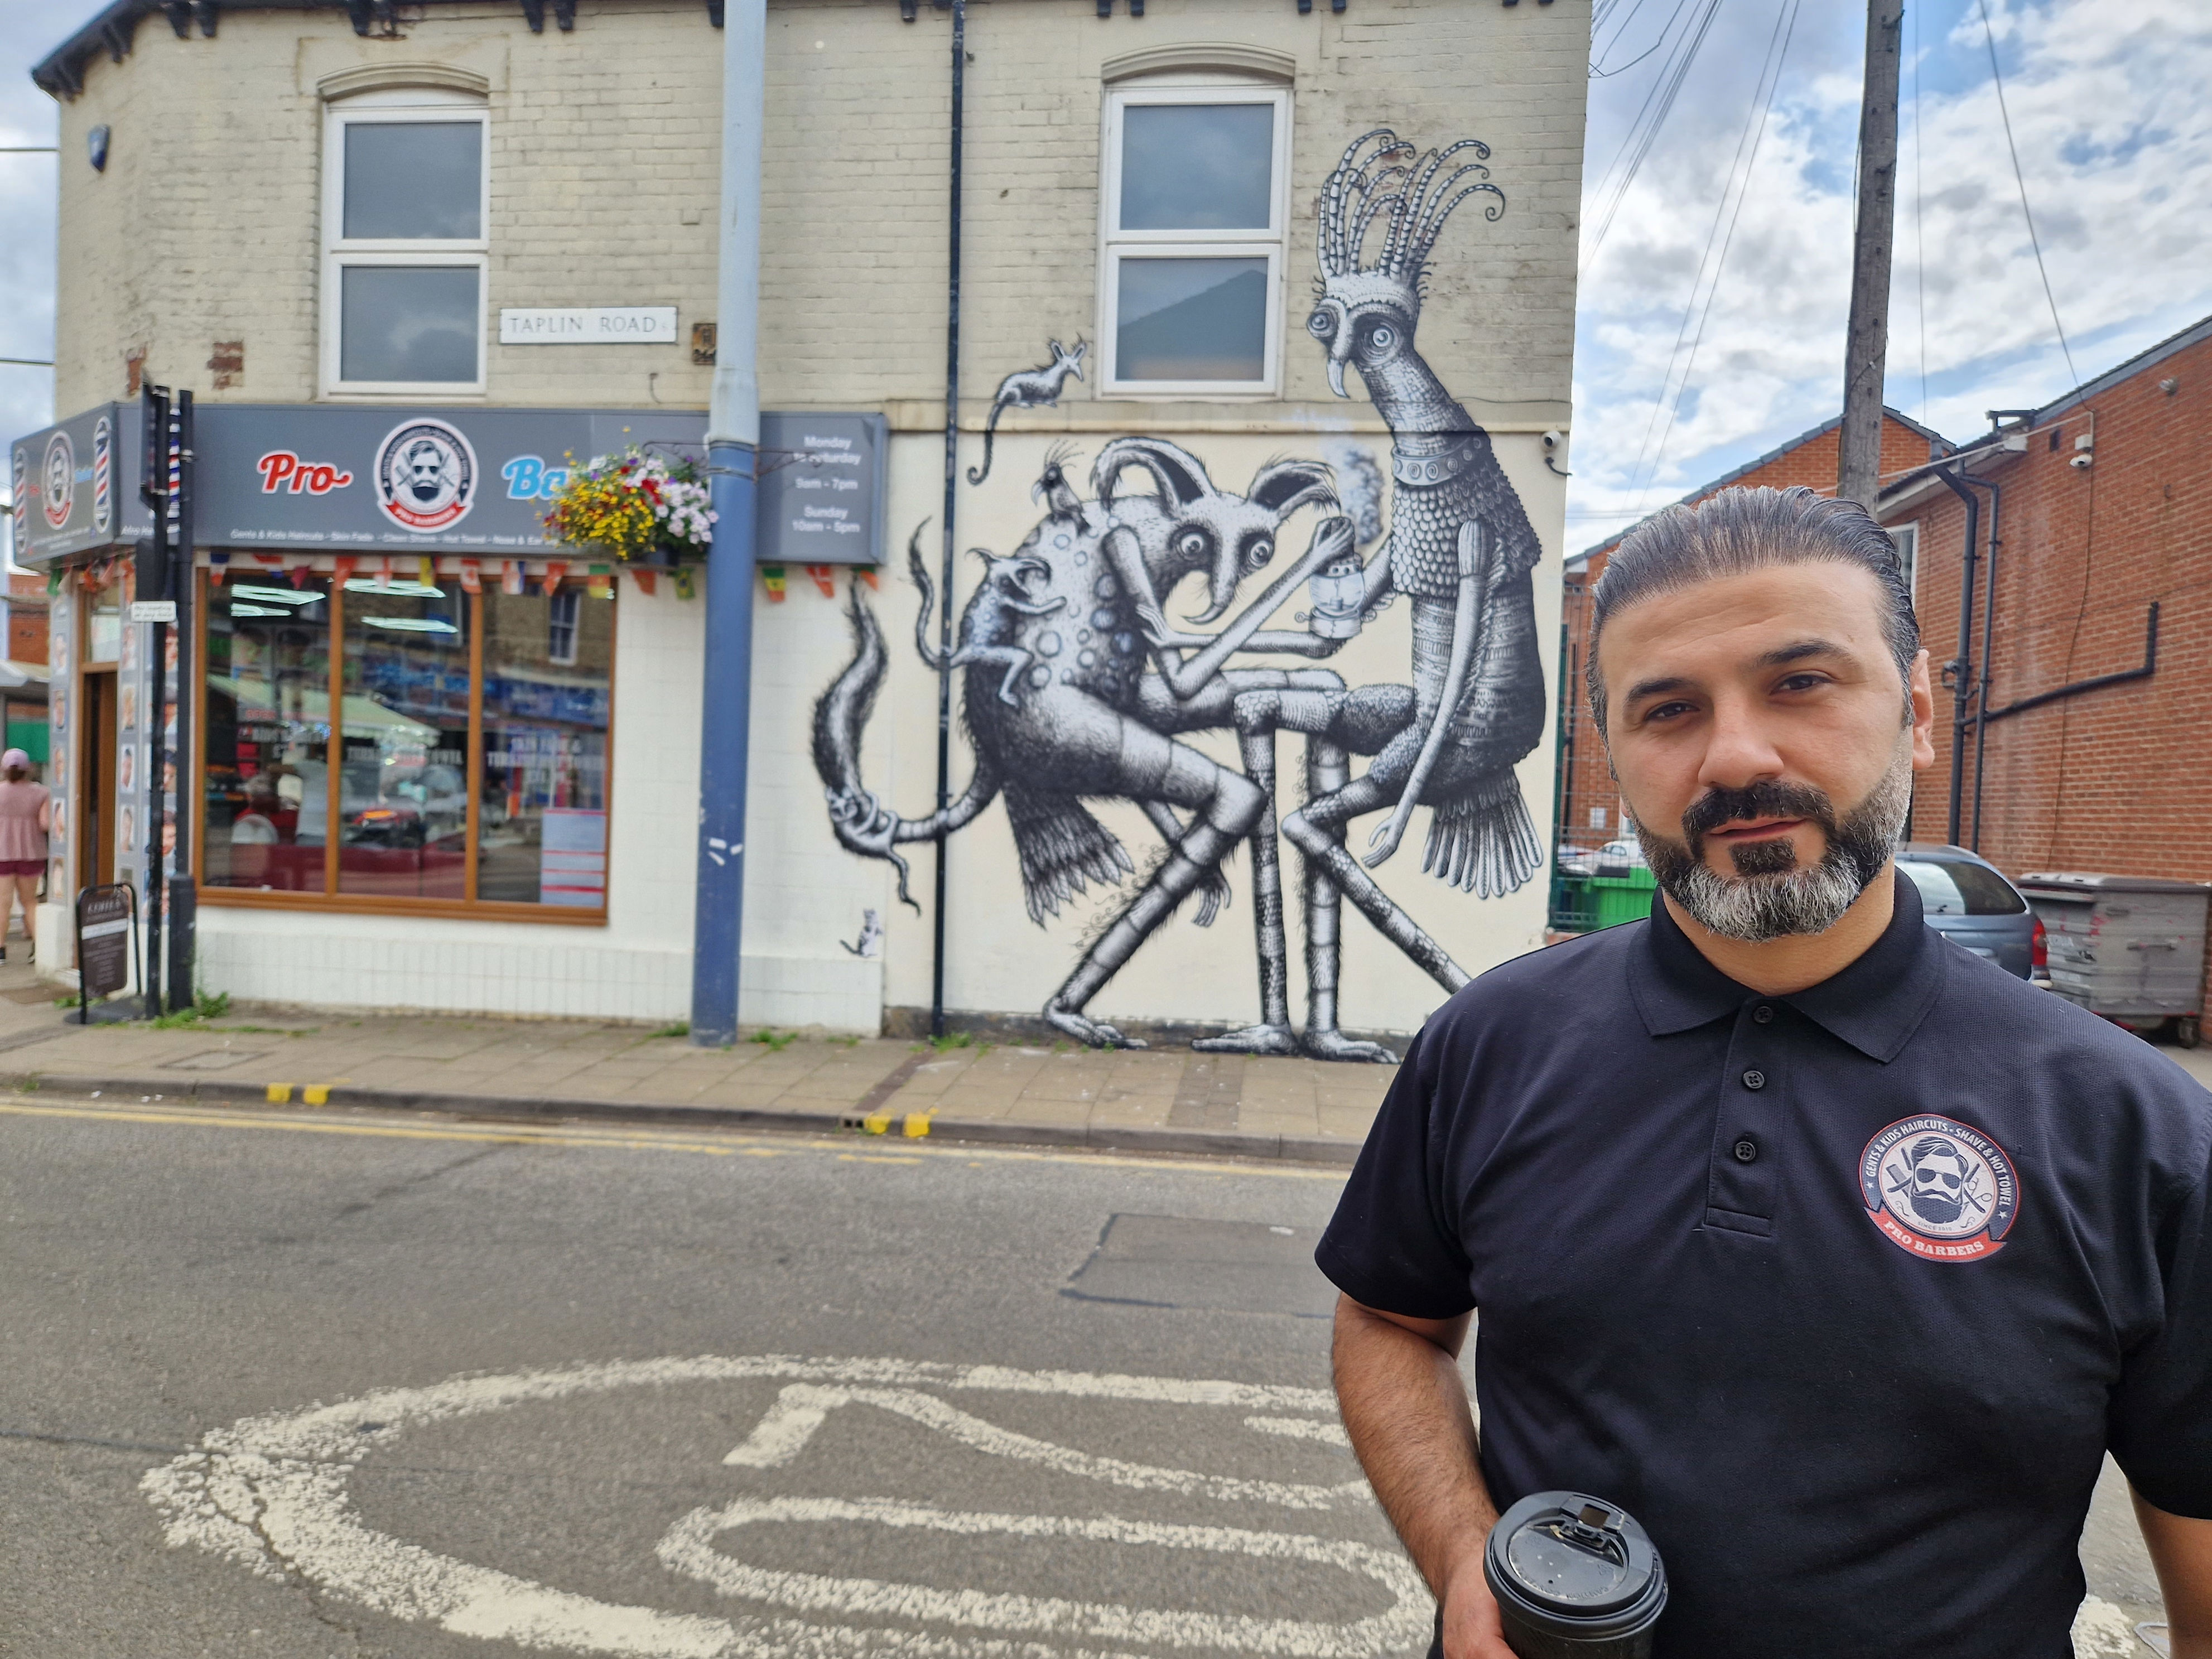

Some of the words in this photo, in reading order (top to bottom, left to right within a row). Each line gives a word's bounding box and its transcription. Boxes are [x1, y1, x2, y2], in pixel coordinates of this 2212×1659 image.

[509, 316, 583, 334] TAPLIN
[599, 316, 656, 332] ROAD
[804, 436, 852, 450] Monday
[259, 452, 351, 493] Pro
[832, 478, 859, 491] 7pm
[804, 505, 849, 520] Sunday
[1900, 1119, 1949, 1134] HAIRCUTS
[1881, 1128, 1903, 1147] KIDS
[1954, 1127, 1984, 1151] SHAVE
[1874, 1144, 1886, 1154] &
[1982, 1147, 1992, 1158] &
[1866, 1151, 1881, 1178] GENTS
[1988, 1154, 2007, 1178] HOT
[1997, 1174, 2012, 1207] TOWEL
[1917, 1221, 1936, 1231] SINCE
[1883, 1221, 1912, 1245] PRO
[1913, 1241, 1986, 1256] BARBERS
